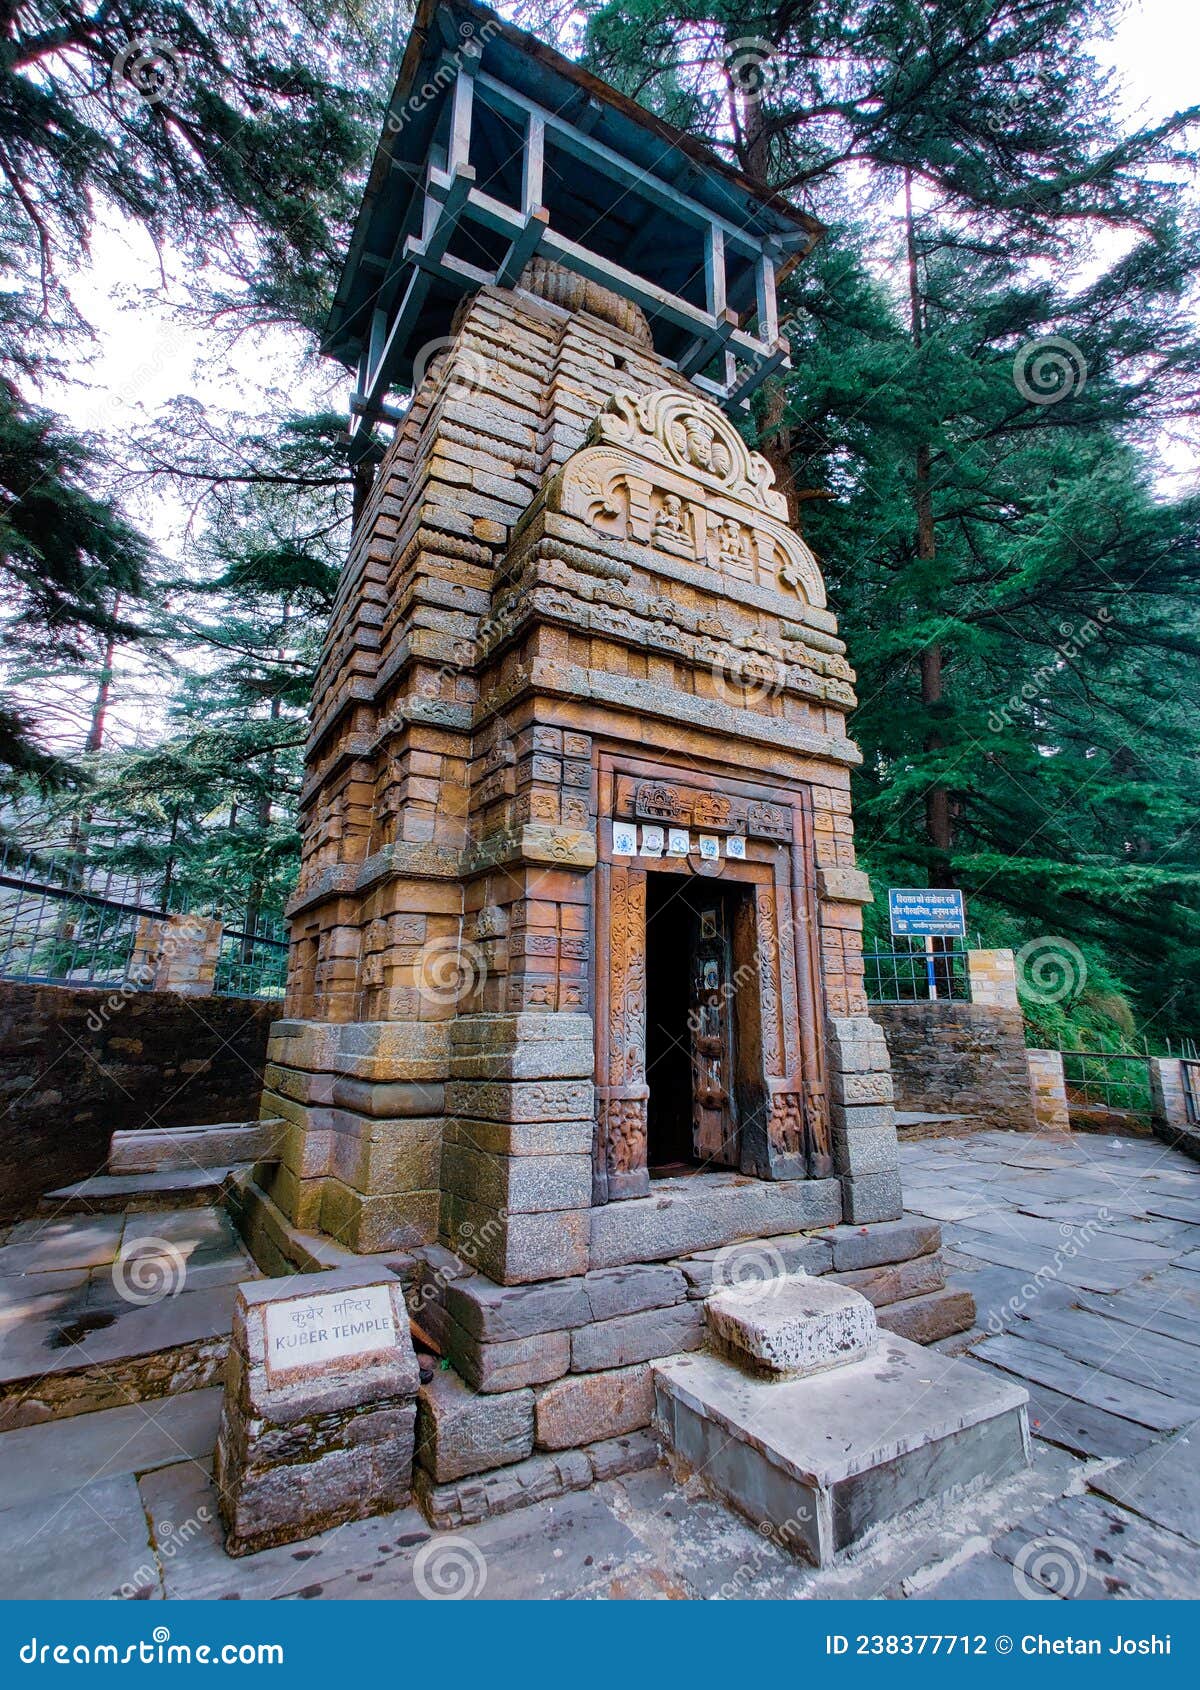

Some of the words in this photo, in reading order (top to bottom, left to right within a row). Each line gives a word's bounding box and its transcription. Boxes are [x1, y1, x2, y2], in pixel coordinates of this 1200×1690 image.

[290, 1304, 324, 1328] कुबेर
[276, 1329, 328, 1350] KUBER
[332, 1317, 390, 1339] TEMPLE
